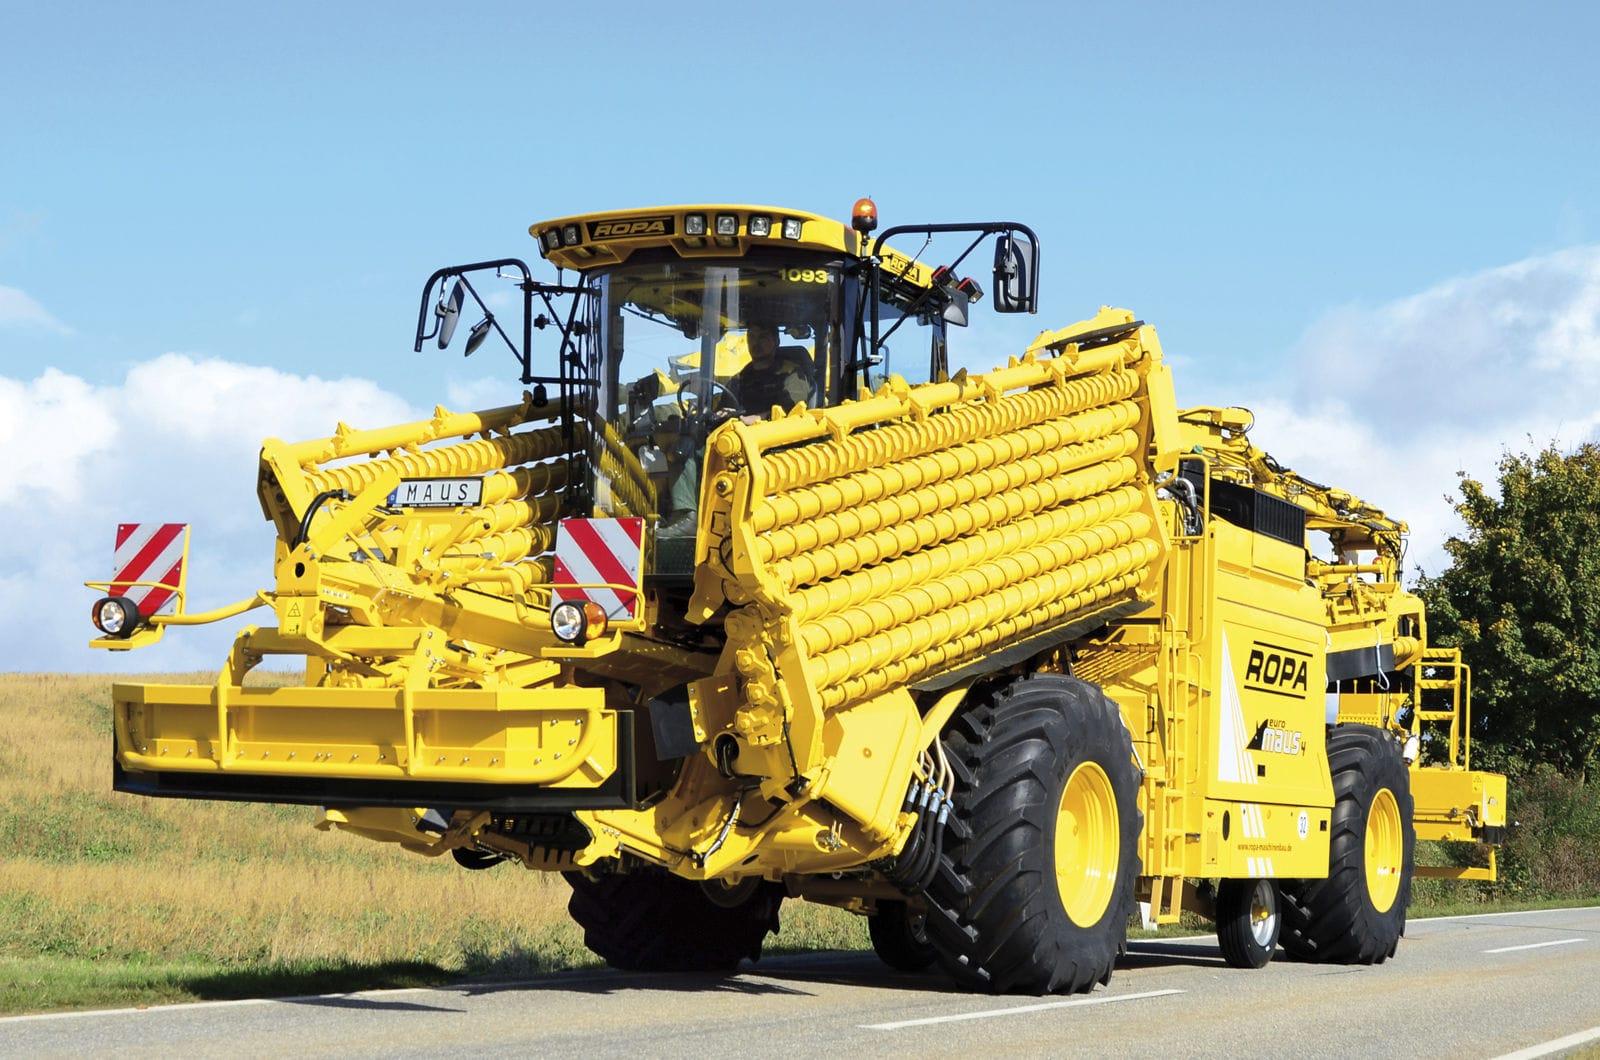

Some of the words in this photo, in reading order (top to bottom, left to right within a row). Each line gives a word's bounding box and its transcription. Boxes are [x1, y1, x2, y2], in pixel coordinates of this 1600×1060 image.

[593, 220, 666, 237] ROPA
[778, 268, 829, 284] 1093
[890, 256, 919, 281] ROA
[406, 483, 469, 502] MAUS
[1246, 649, 1307, 692] ROPA
[1269, 719, 1286, 729] euro
